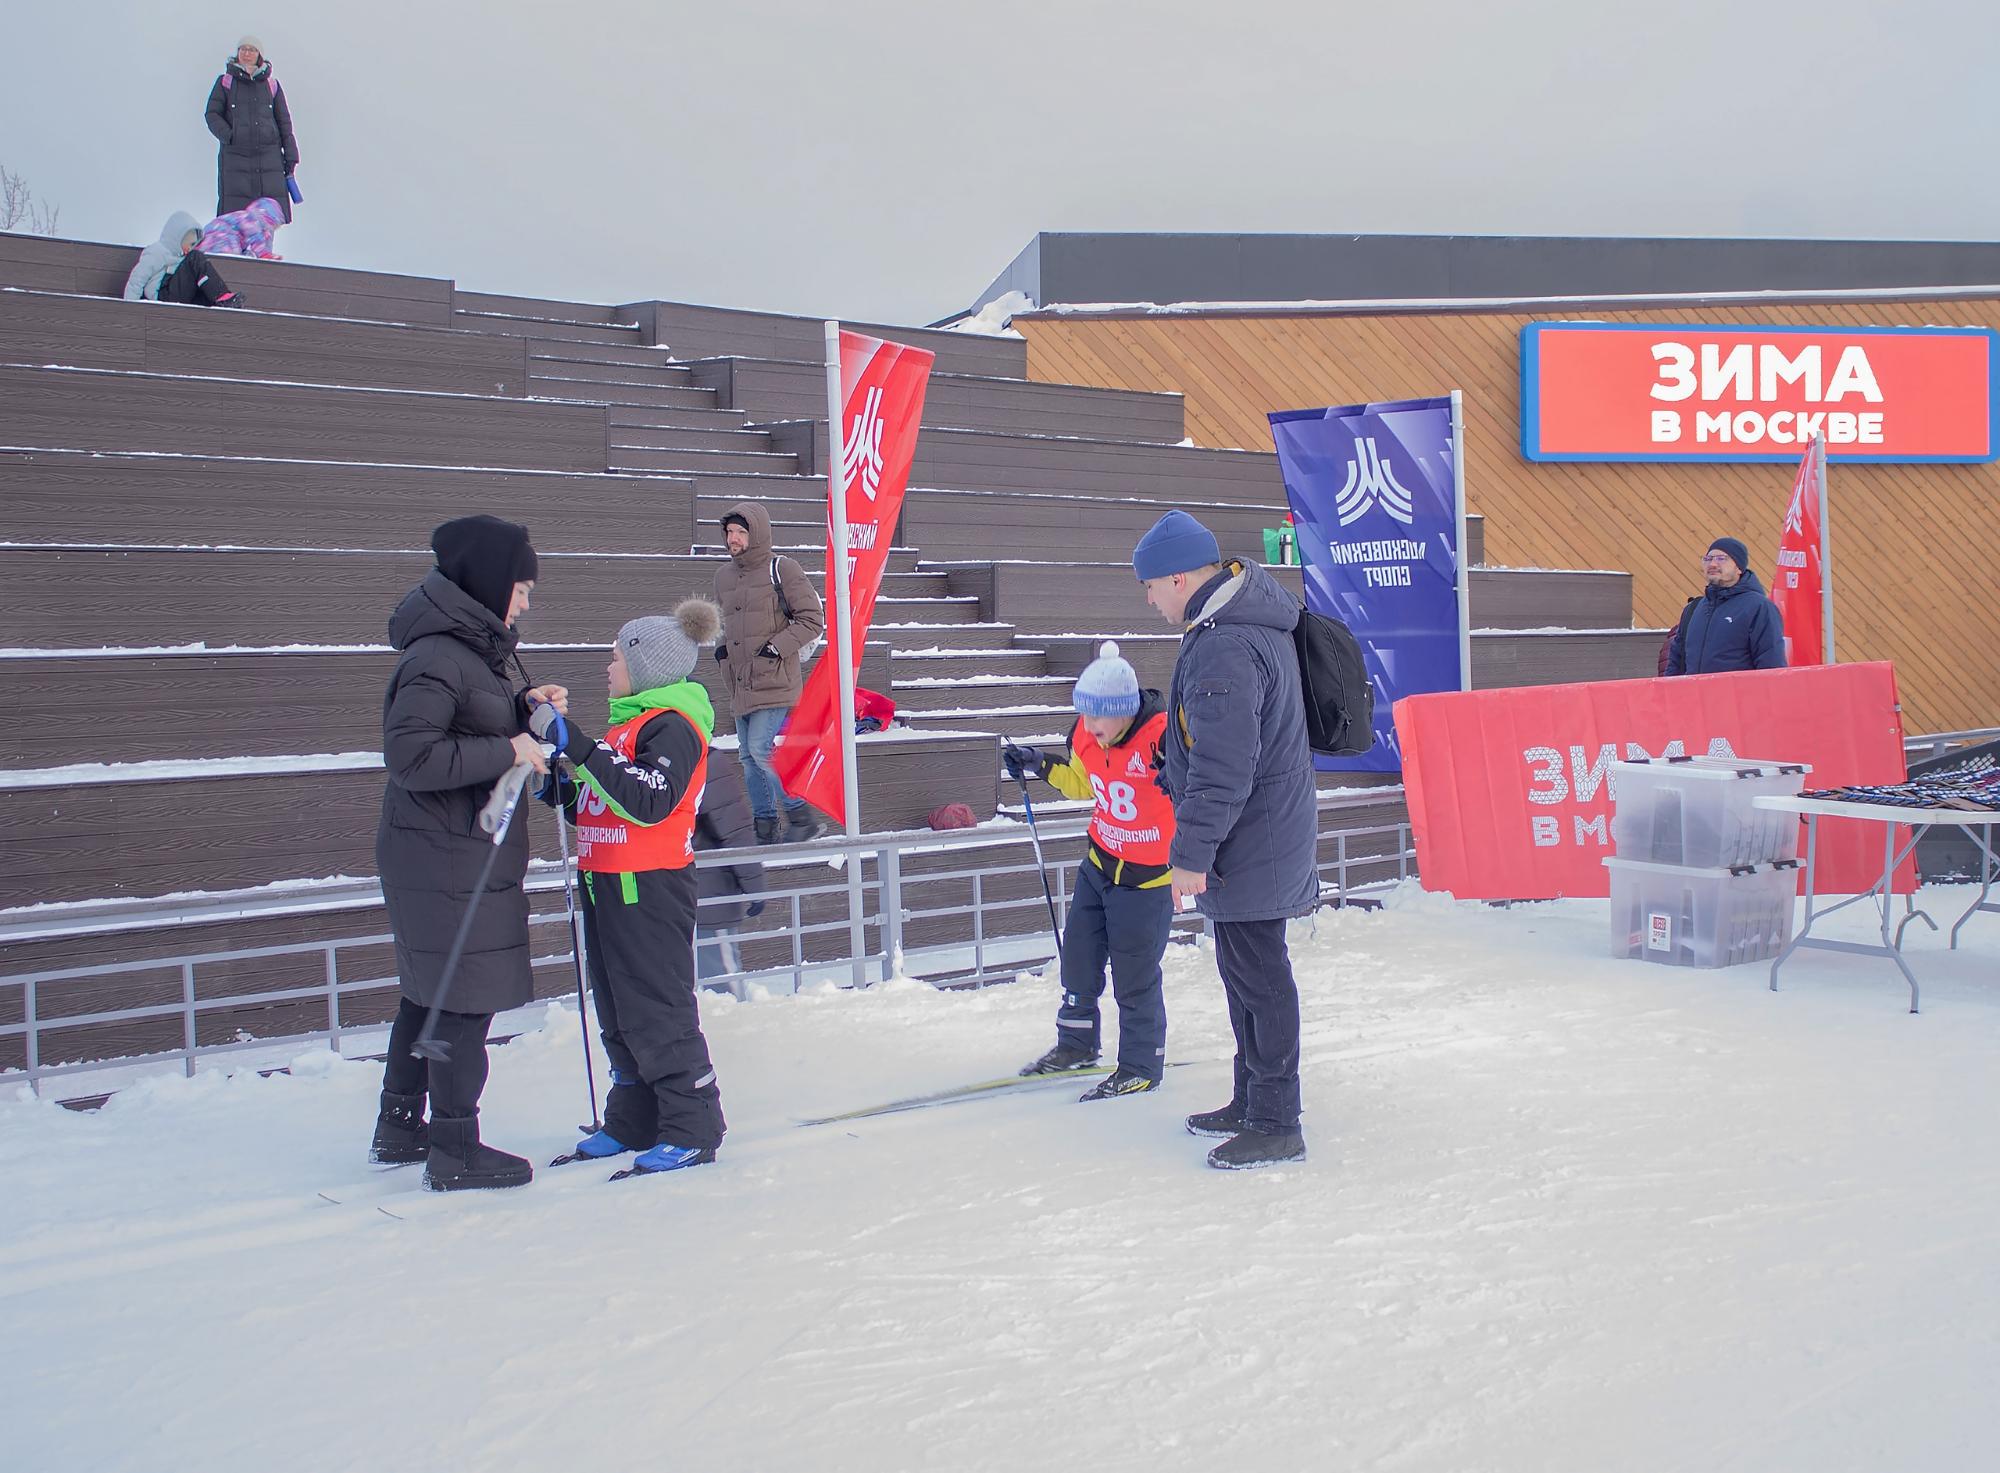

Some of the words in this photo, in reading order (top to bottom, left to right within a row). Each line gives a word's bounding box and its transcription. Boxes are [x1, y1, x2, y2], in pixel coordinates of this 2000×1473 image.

[1650, 342, 1884, 402] ЗИМА
[1651, 410, 1682, 442] В
[1696, 411, 1884, 443] МОСКВЕ
[1533, 816, 1561, 847] В
